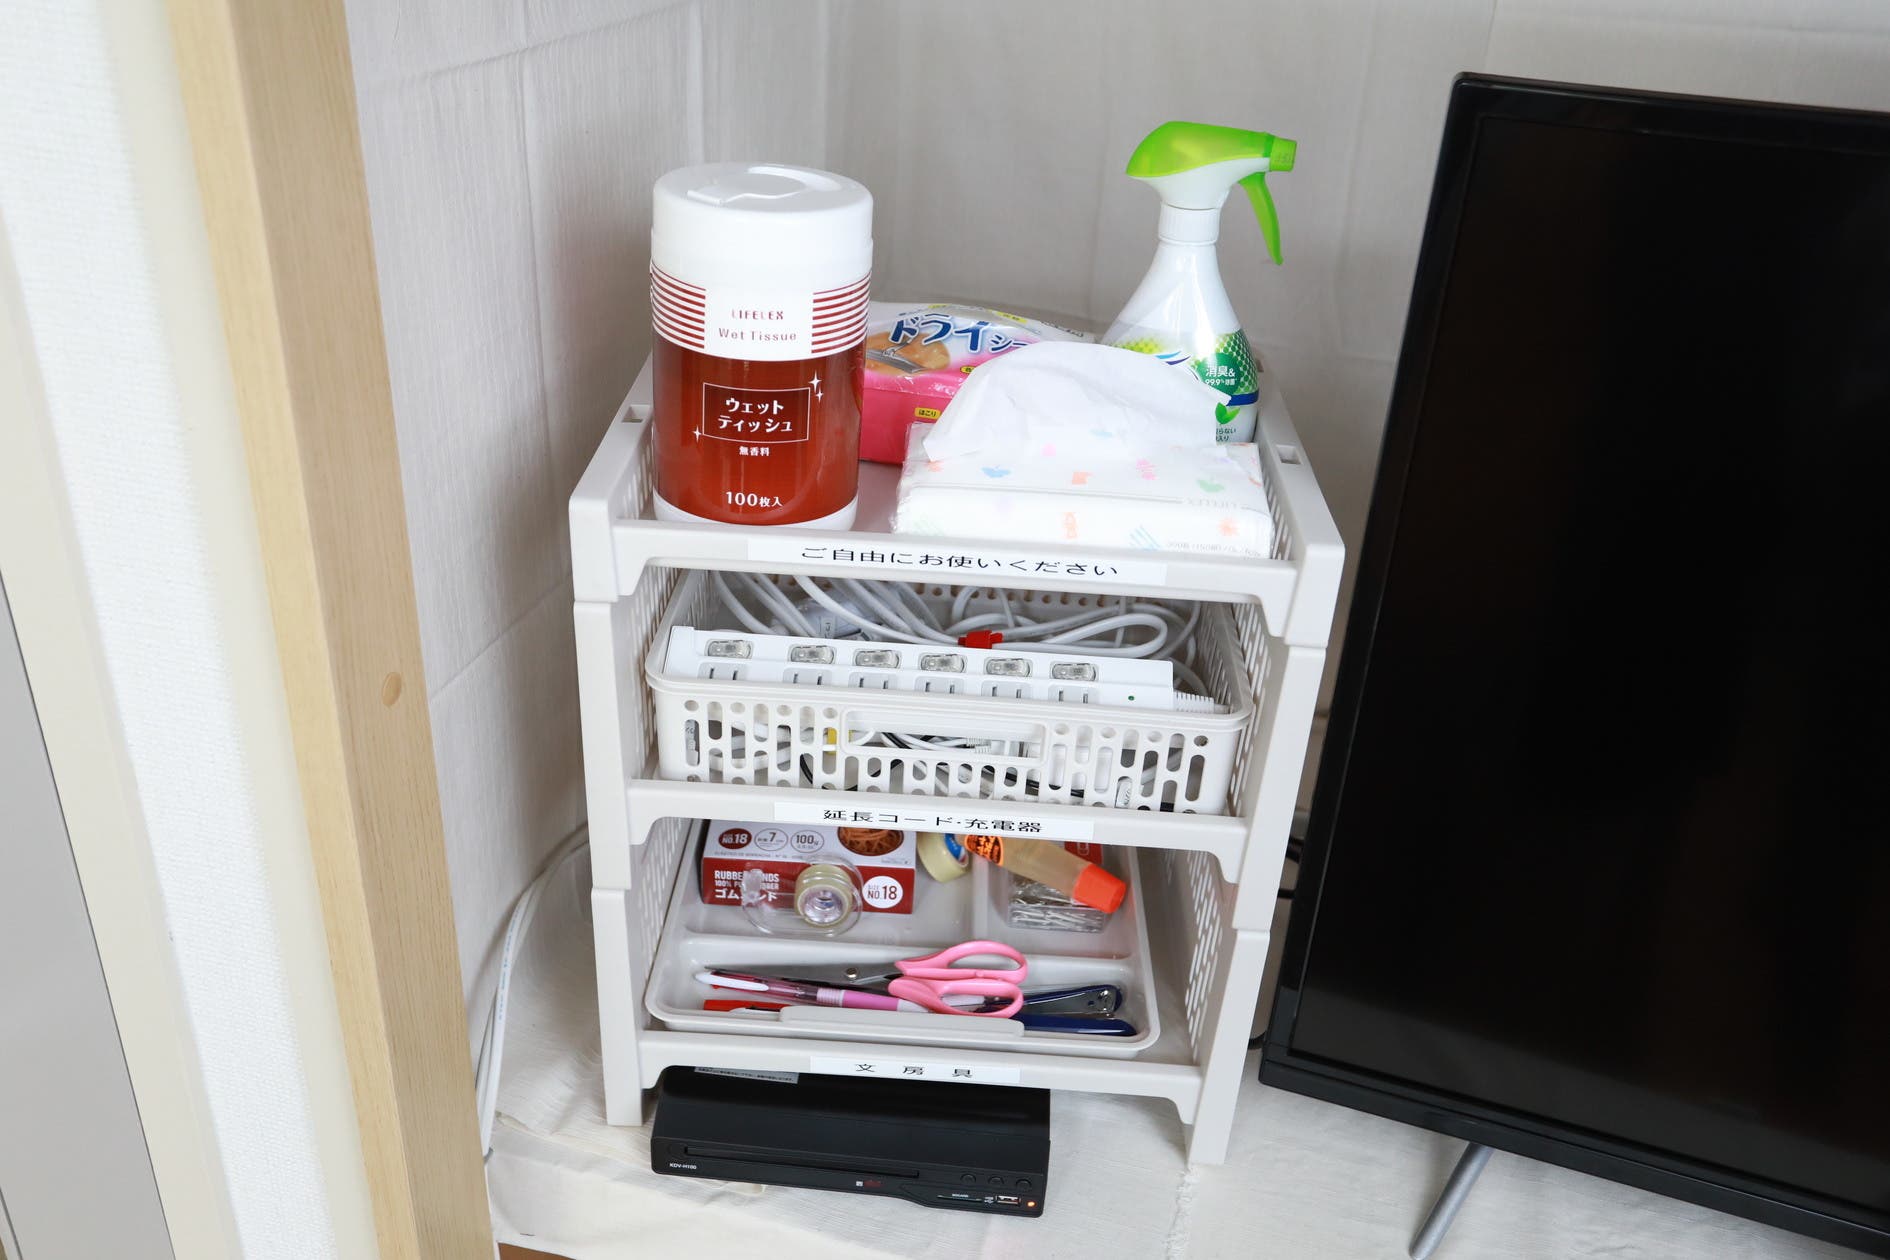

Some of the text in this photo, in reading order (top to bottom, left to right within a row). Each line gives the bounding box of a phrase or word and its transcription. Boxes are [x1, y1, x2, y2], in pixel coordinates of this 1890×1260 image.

[731, 309, 784, 320] LIFELEX
[719, 327, 797, 341] Wet Tissue
[726, 398, 784, 415] ウェット
[718, 415, 793, 433] ティッシュ
[739, 446, 770, 457] 無香料
[726, 491, 783, 508] 100枚入
[802, 547, 1118, 577] ご自由にお使いください
